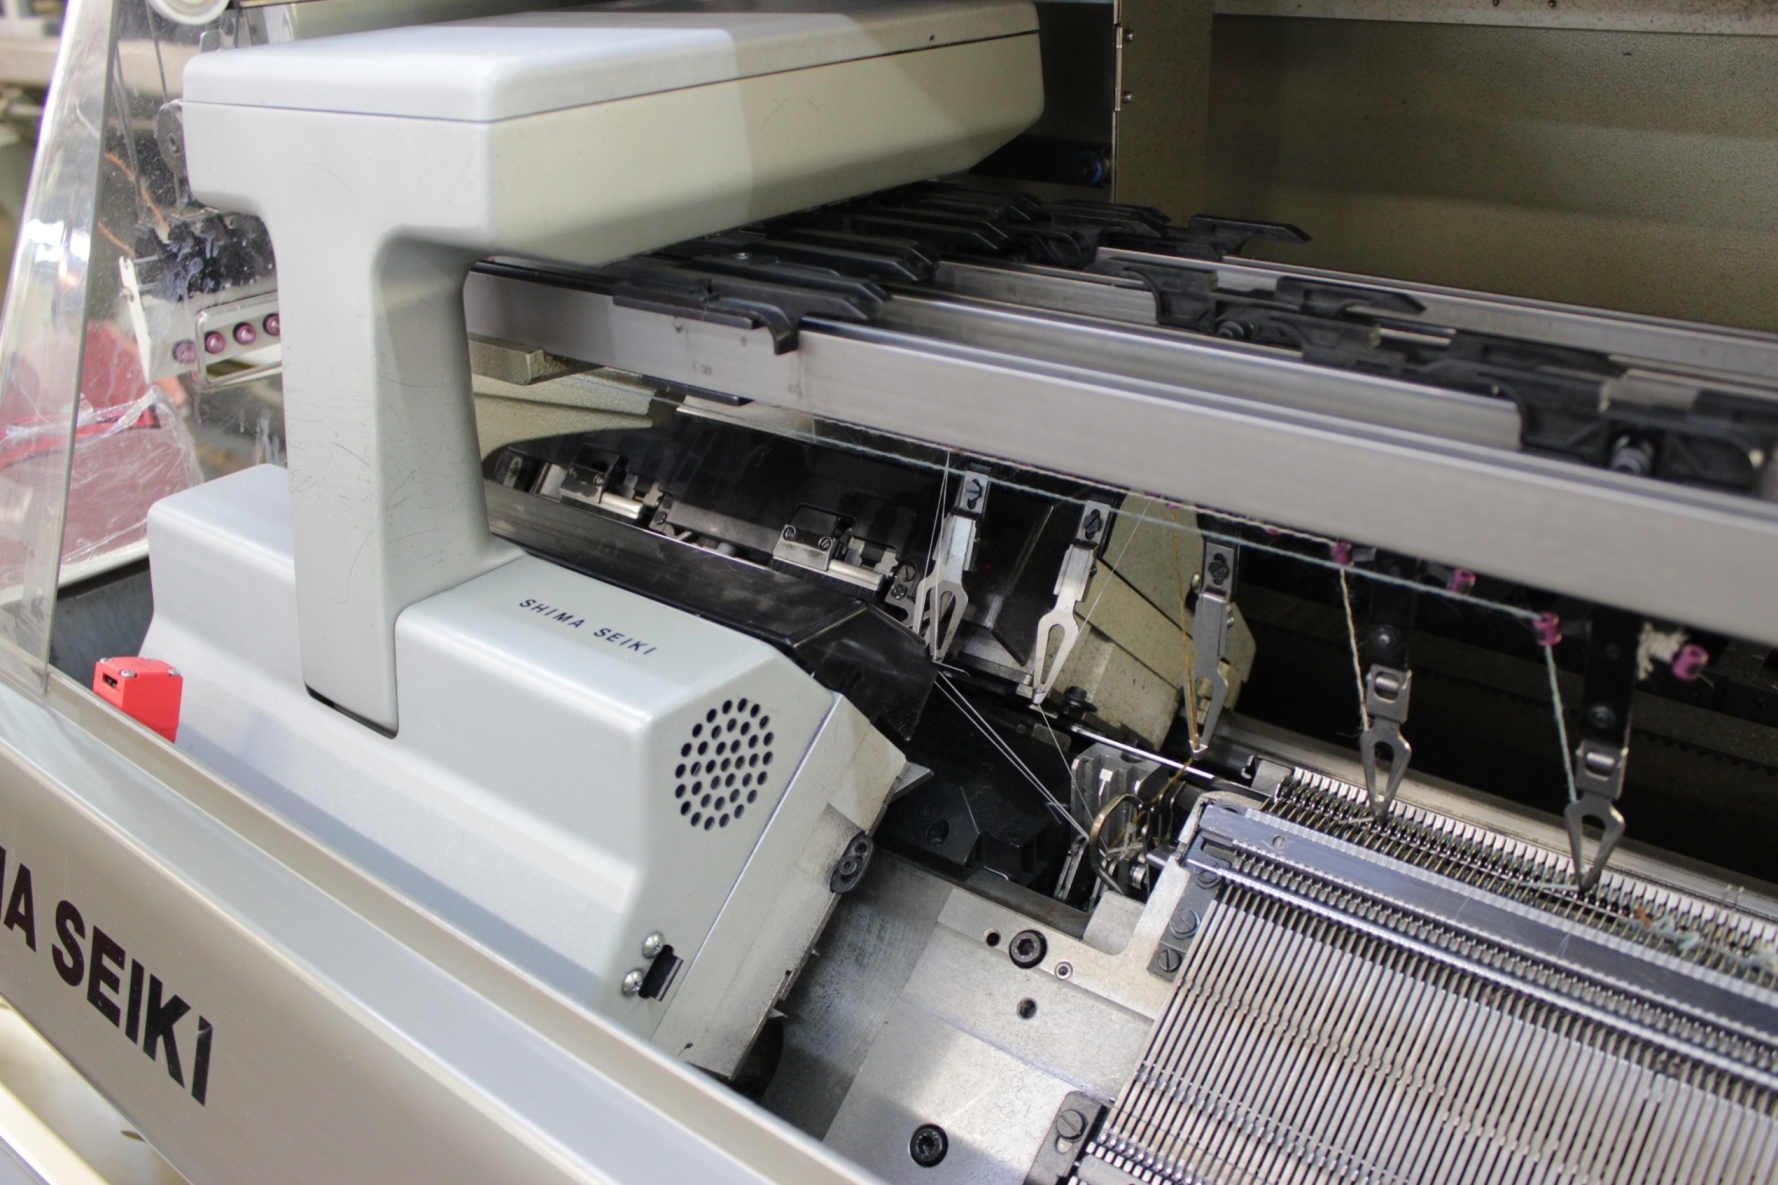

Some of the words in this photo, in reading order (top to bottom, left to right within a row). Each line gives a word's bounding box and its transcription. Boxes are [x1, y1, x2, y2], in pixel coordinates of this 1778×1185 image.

[519, 599, 585, 628] SHIMA
[593, 628, 657, 655] SEIKI
[0, 845, 37, 953] A
[51, 900, 213, 1107] SEIKI
